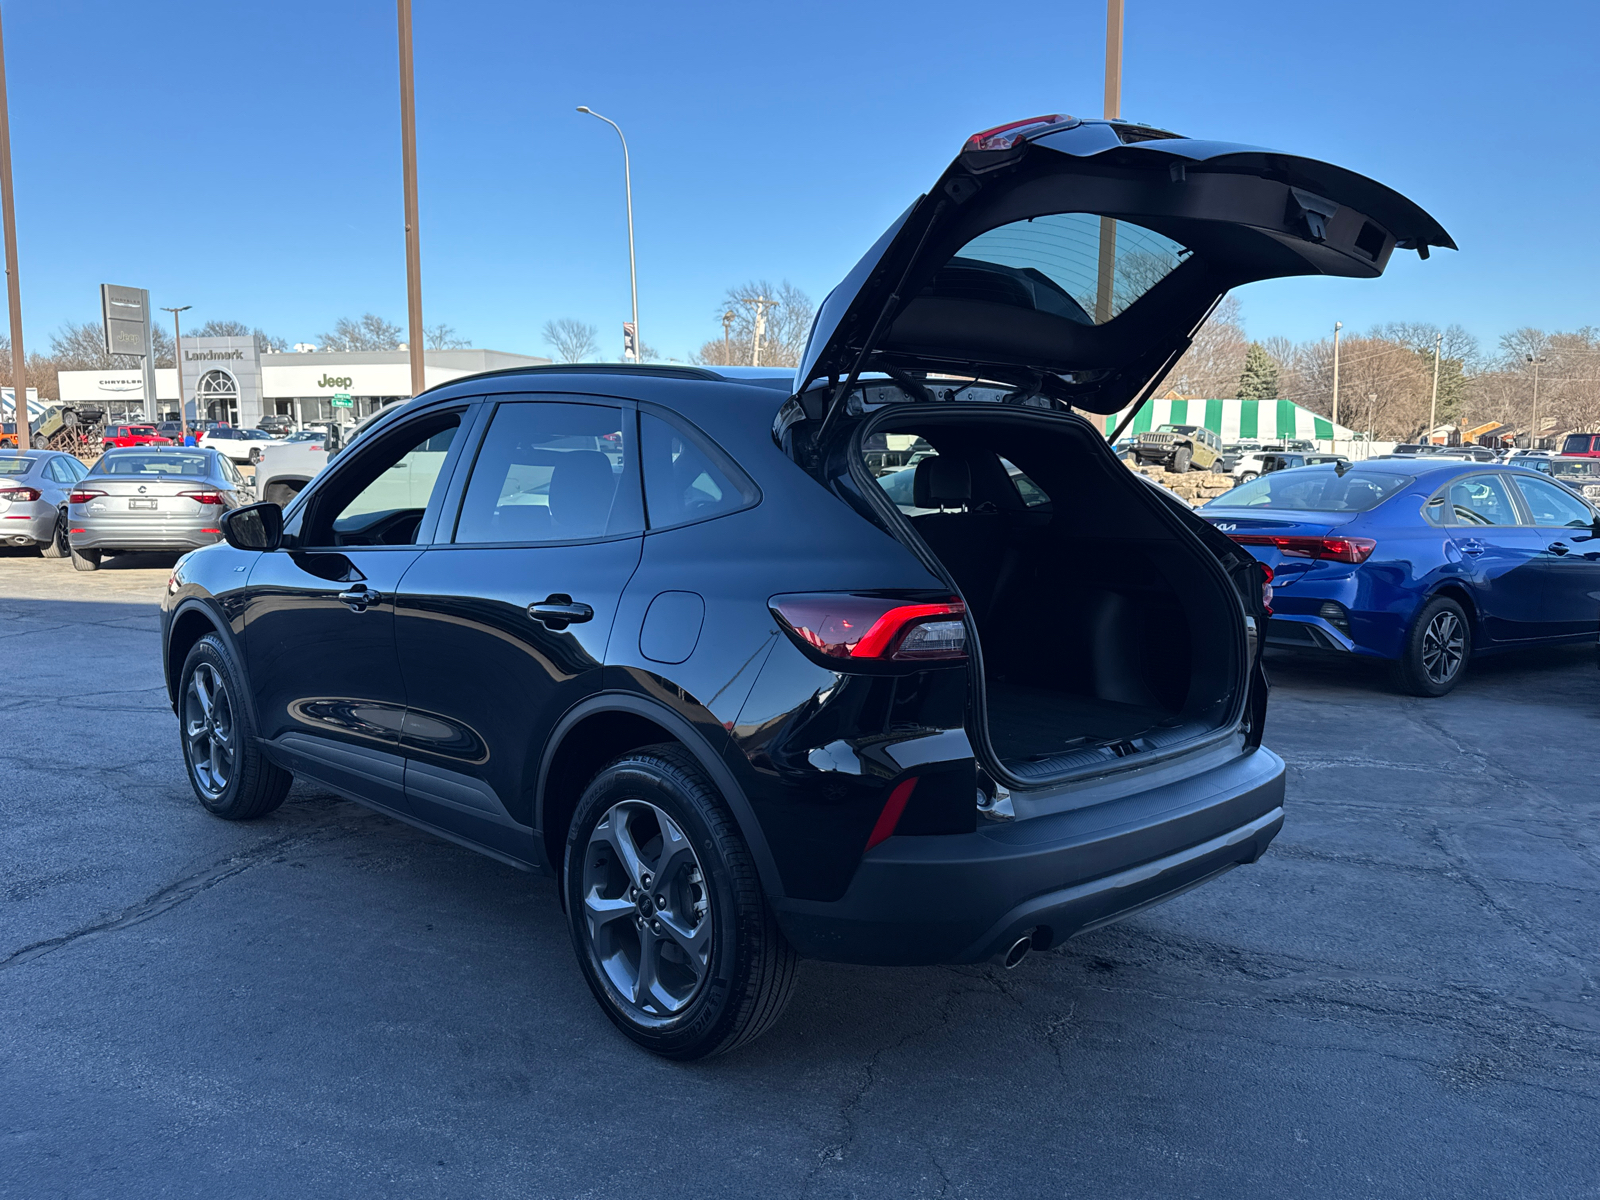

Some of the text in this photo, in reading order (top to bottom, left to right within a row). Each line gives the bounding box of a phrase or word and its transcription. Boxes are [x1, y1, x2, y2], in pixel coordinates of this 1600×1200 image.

[117, 330, 139, 345] Jeep
[184, 349, 244, 361] Landmark
[317, 373, 353, 390] Jeep
[578, 776, 614, 820] MICHELIN
